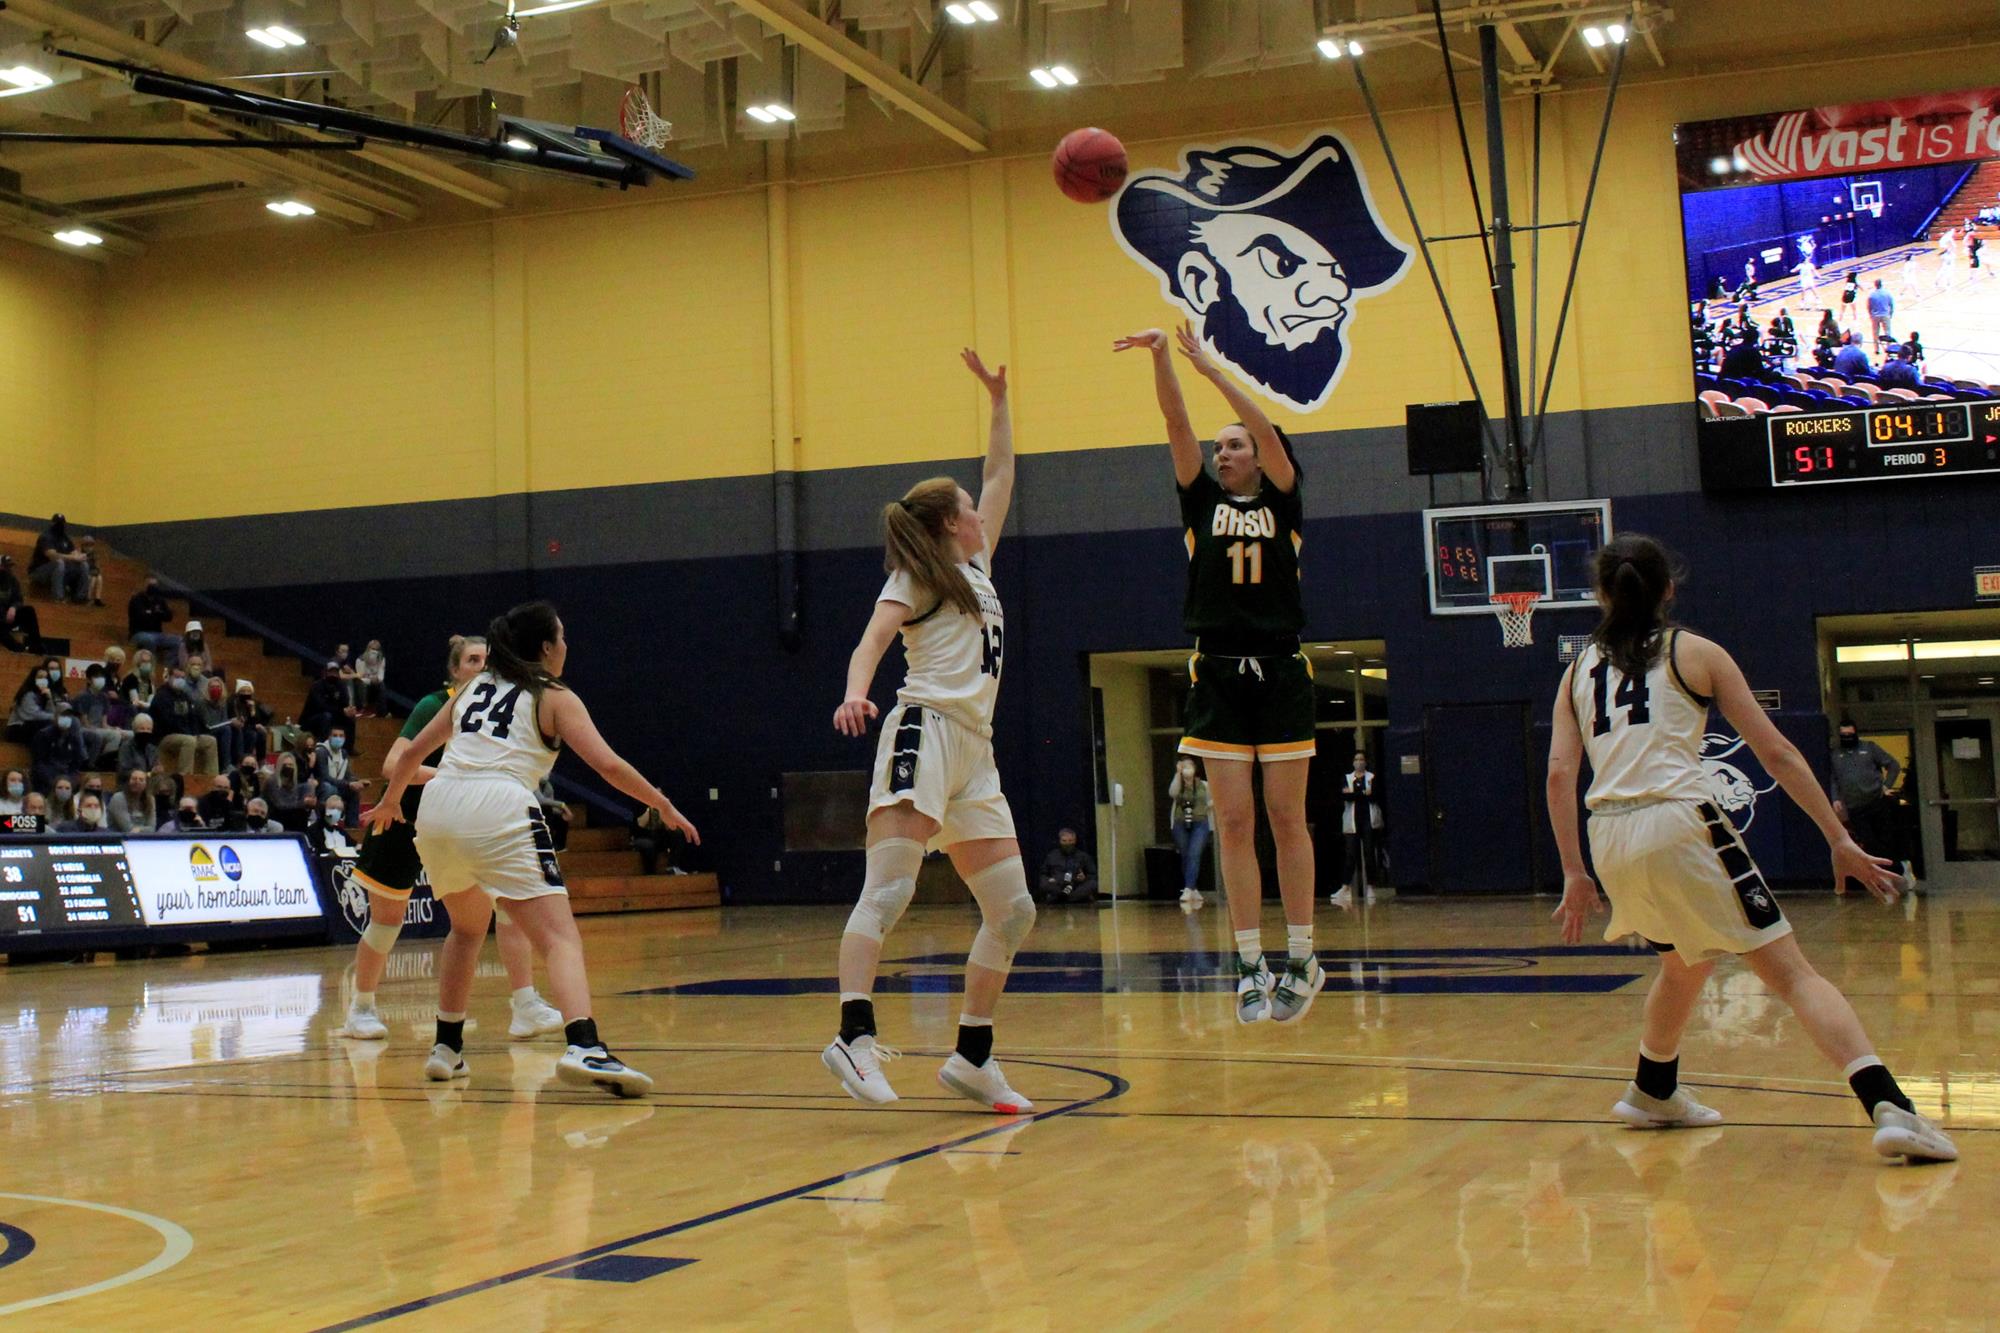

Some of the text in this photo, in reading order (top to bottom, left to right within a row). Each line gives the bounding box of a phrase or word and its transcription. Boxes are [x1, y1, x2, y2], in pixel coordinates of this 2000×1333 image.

[1801, 117, 1908, 172] vast
[1916, 124, 1954, 160] IS
[1786, 417, 1851, 436] ROCKERS
[1795, 446, 1835, 472] 51
[1884, 448, 1947, 467] PERIOD 3
[1212, 503, 1277, 538] BHSU
[1226, 541, 1263, 584] 11
[460, 683, 523, 740] 24
[1590, 658, 1650, 738] 14
[11, 815, 37, 828] POSS
[191, 865, 216, 877] RMAC
[17, 905, 36, 922] 51
[157, 882, 308, 920] your hometown team
